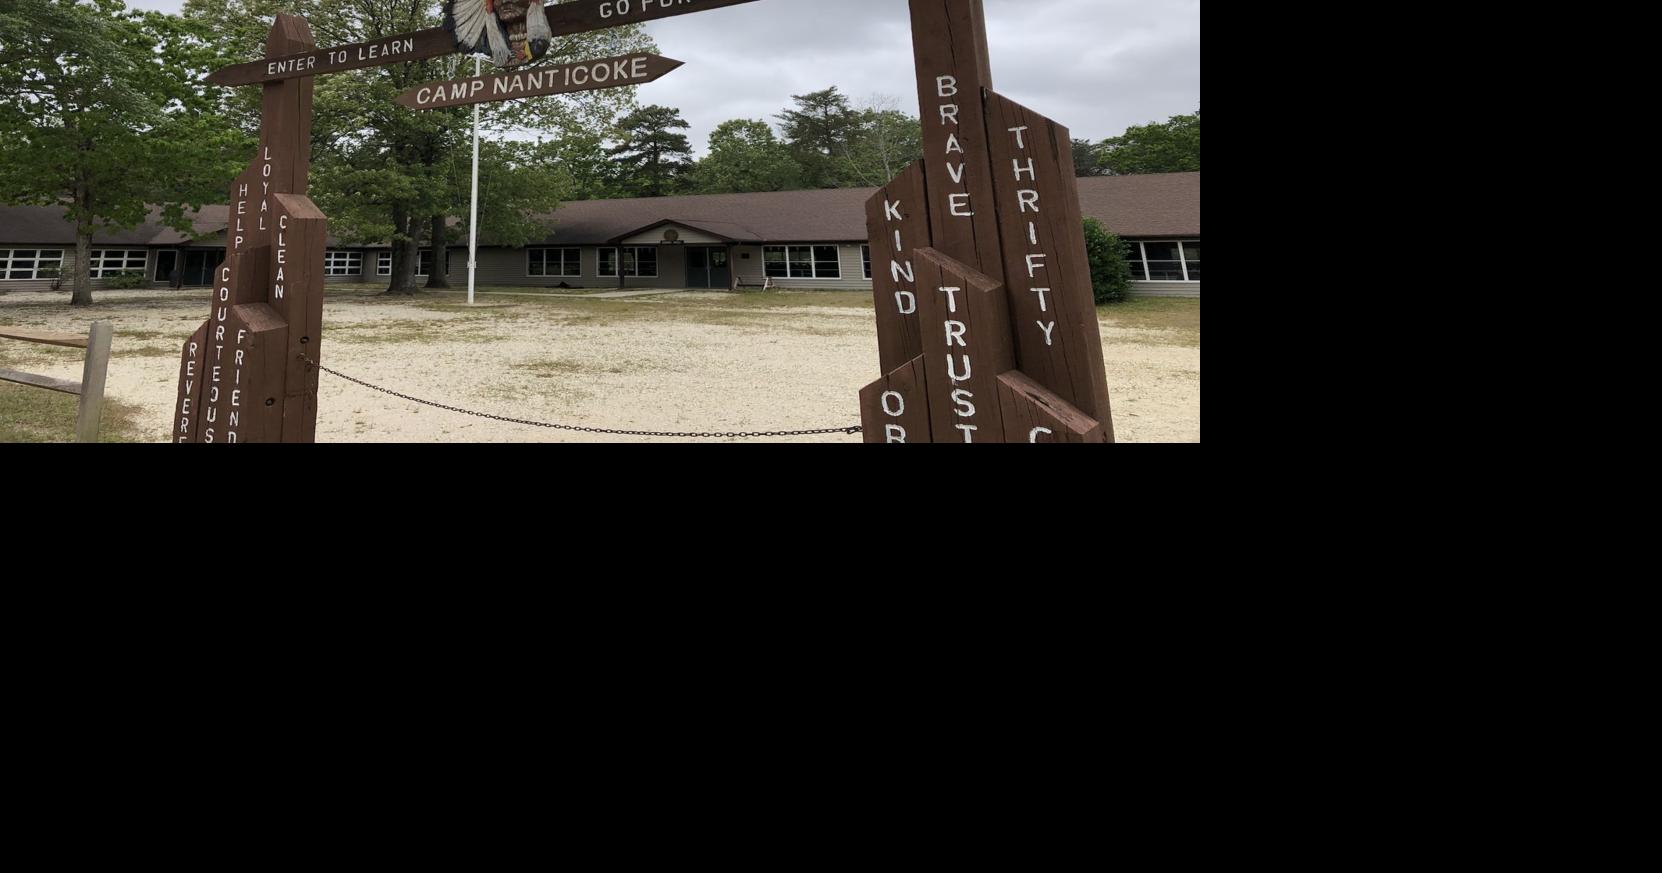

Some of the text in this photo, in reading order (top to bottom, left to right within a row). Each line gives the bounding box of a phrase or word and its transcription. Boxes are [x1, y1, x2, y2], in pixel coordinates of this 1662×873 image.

[600, 0, 630, 18] GO
[267, 38, 414, 76] ENTER TO LEARN
[416, 56, 648, 104] CAMP NANTICOKE
[936, 75, 975, 217] BRAVE
[235, 183, 248, 249] HELP
[259, 147, 271, 231] LOYAL
[275, 215, 288, 299] CLEAN
[884, 199, 916, 314] KIND
[1008, 125, 1055, 346] THRIFTY
[228, 329, 247, 443] FRIEND
[938, 286, 978, 443] TRUST
